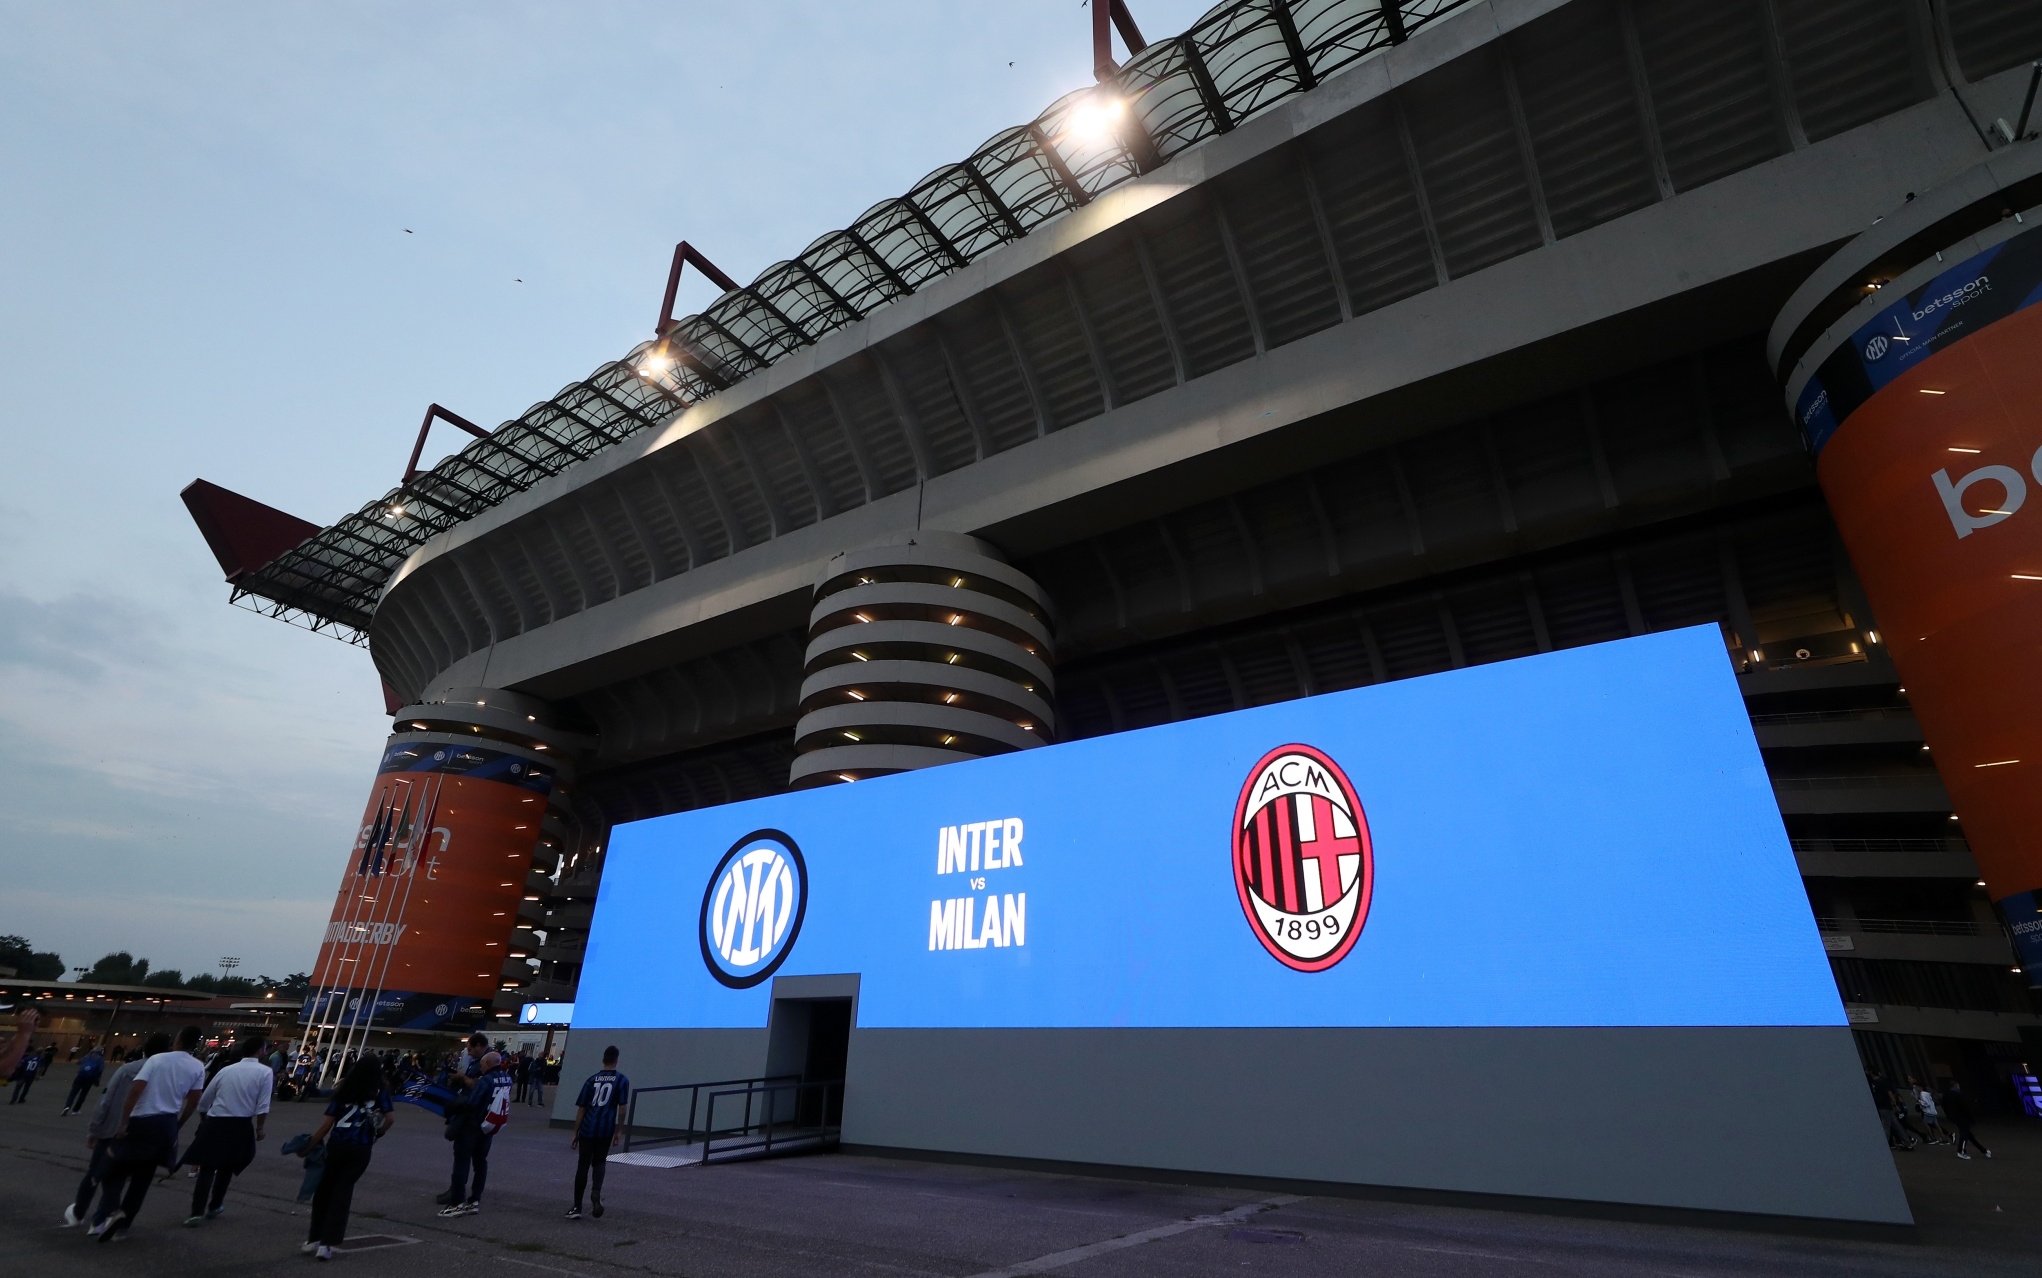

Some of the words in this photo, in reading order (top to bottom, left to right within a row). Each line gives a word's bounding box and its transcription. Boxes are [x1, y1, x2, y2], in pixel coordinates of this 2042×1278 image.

[1912, 276, 1989, 322] betsson
[1899, 344, 1922, 361] OFFICIAL
[1922, 335, 1938, 347] MAIN
[1937, 320, 1964, 338] PARTNER
[1803, 389, 1827, 425] betsson
[1931, 445, 2042, 540] b
[1259, 761, 1331, 803] ACM
[937, 817, 1024, 875] INTER
[928, 892, 1026, 951] MILAN
[1275, 915, 1340, 941] 1899
[26, 1060, 39, 1072] 10
[591, 1082, 613, 1107] 10
